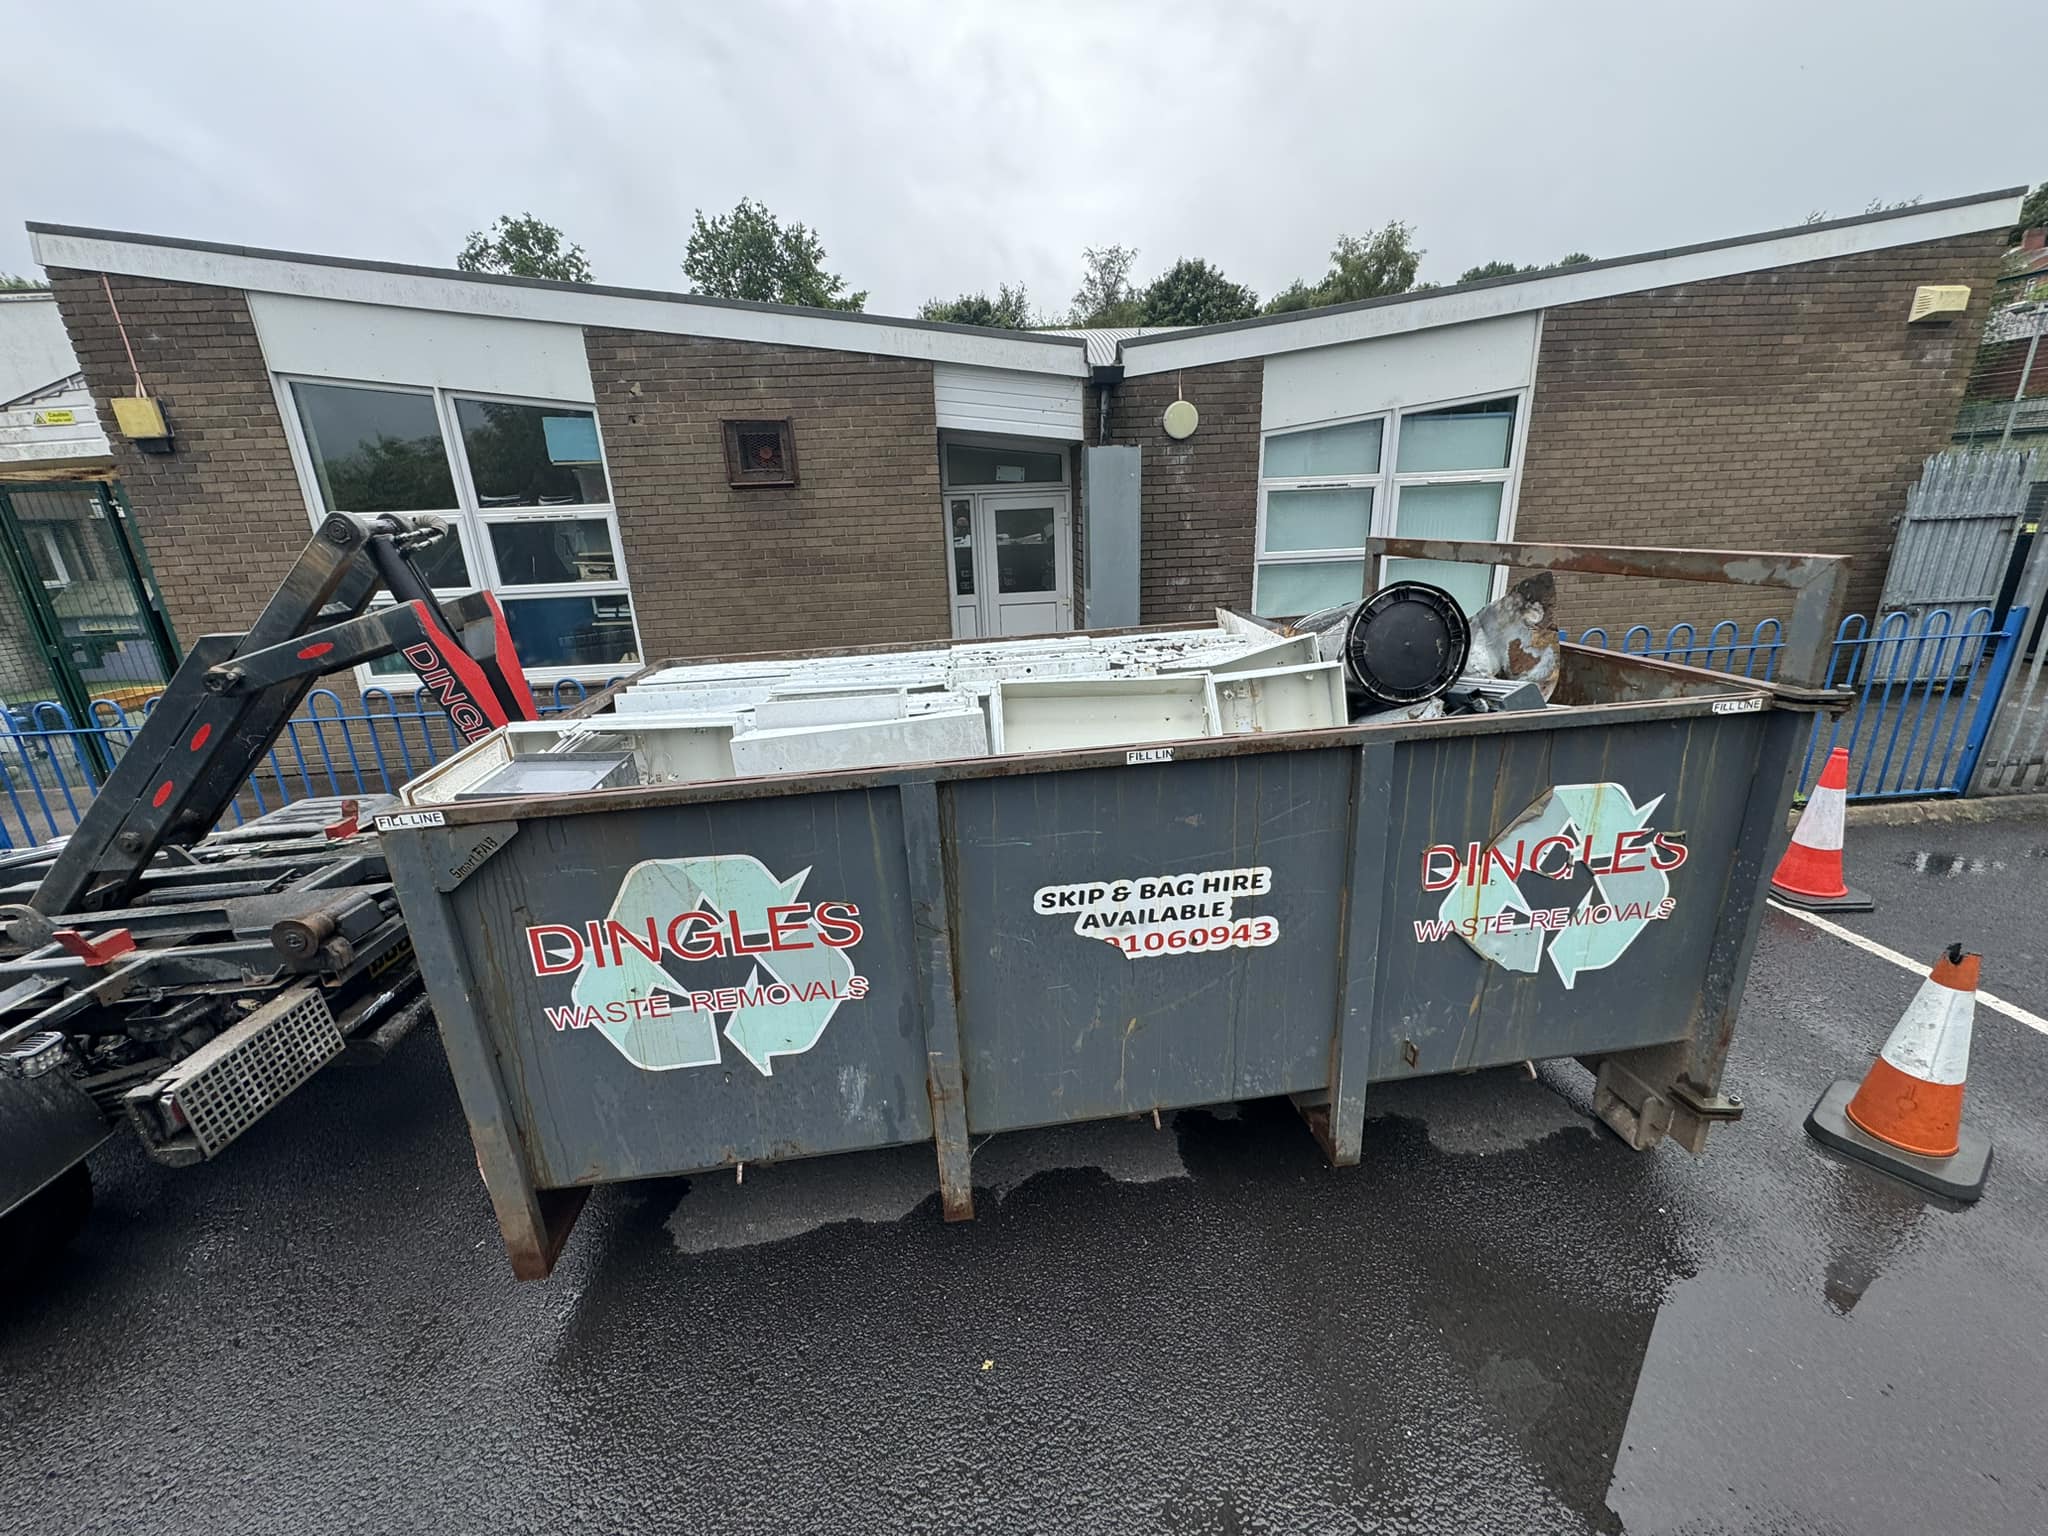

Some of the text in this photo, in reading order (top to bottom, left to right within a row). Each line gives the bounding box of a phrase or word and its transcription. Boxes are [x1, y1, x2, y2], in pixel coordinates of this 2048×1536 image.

[1714, 700, 1760, 711] FILL LINE
[1128, 751, 1153, 761] FILL
[379, 812, 441, 828] FILL LINE
[1040, 873, 1265, 909] SKIP & BAG HIRE
[1081, 901, 1226, 930] AVAILABLE
[1414, 897, 1676, 943] WASTE REMOVALS
[526, 902, 863, 976] DINGLES
[544, 976, 869, 1031] WASTE REMOVALS
